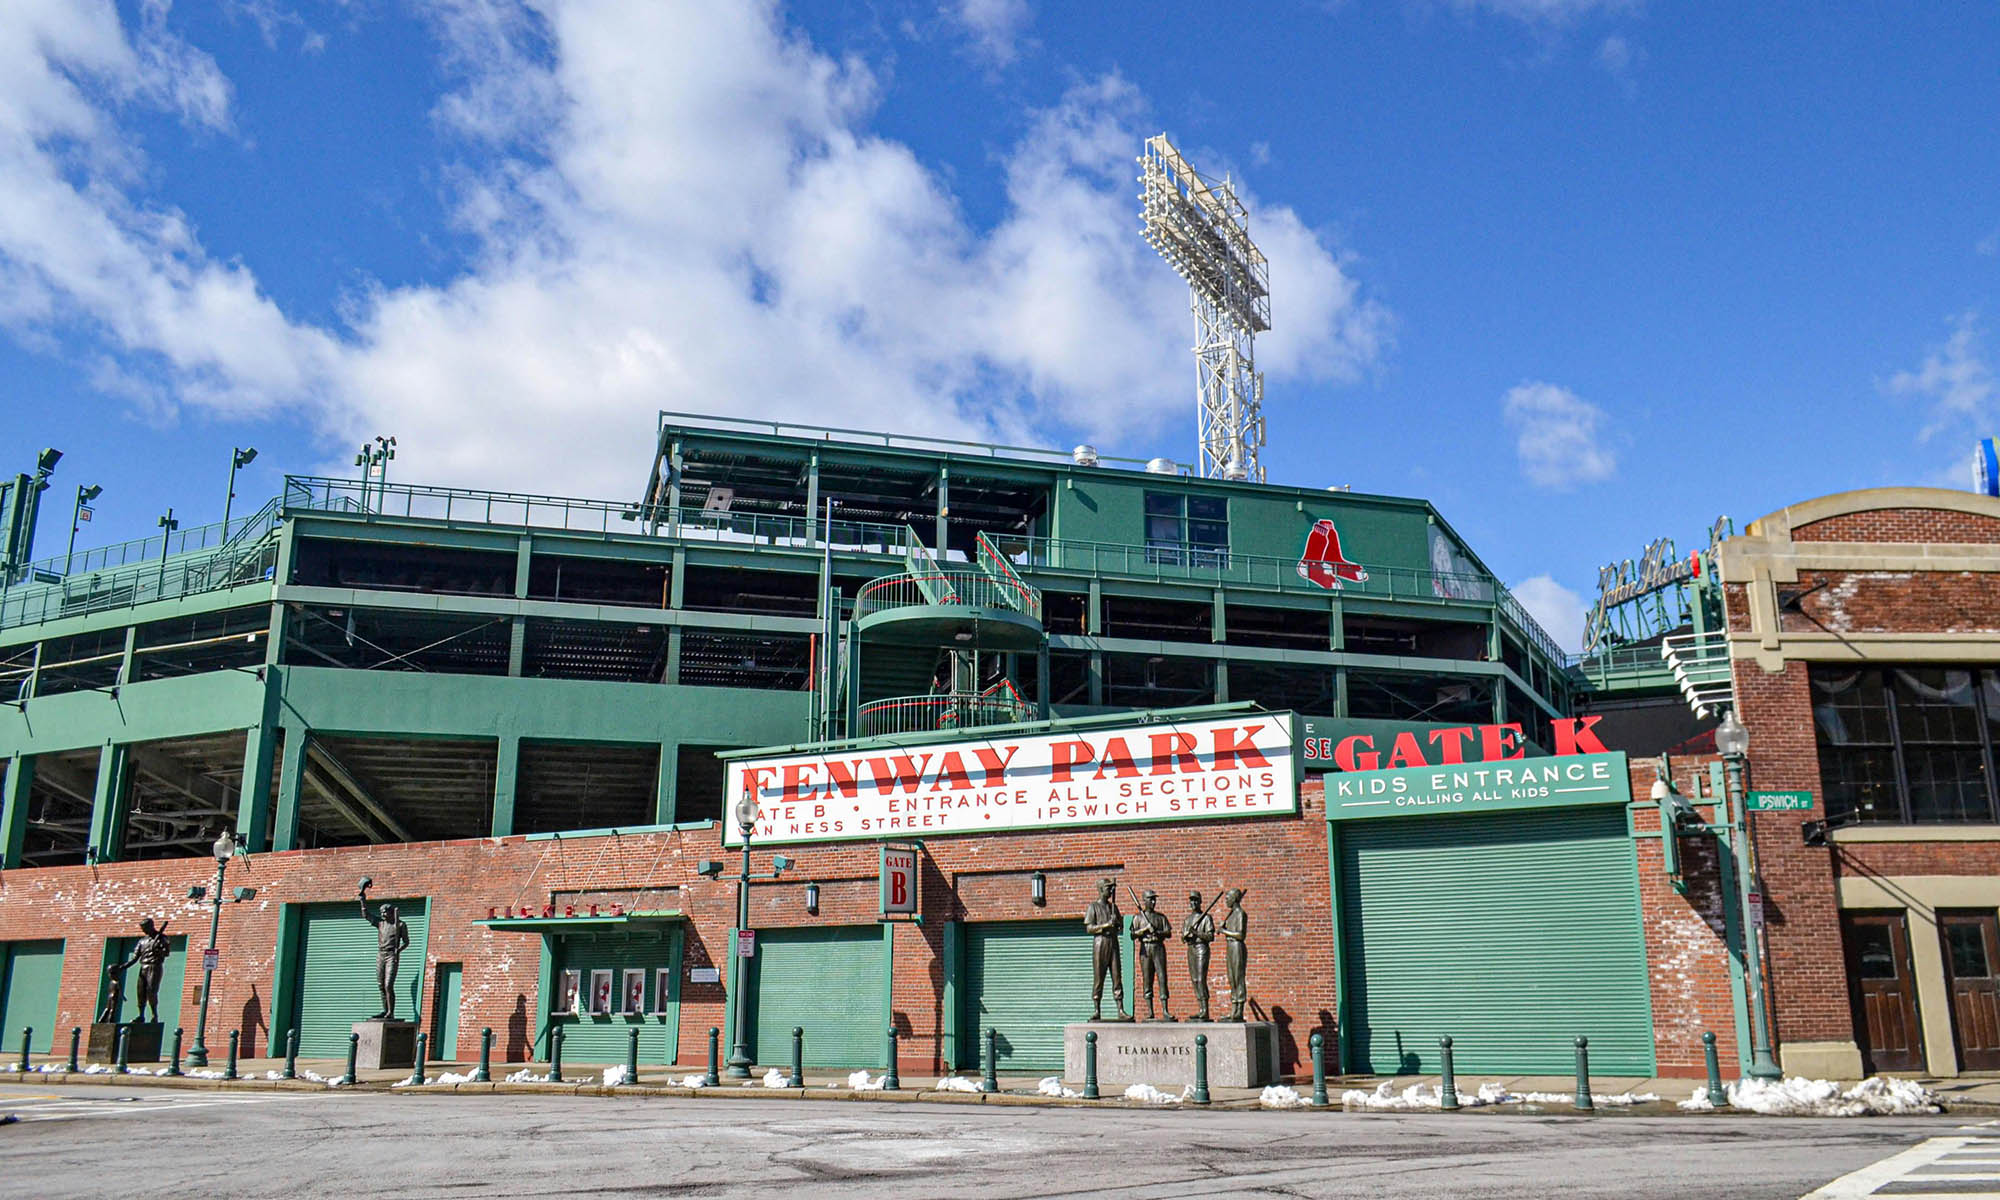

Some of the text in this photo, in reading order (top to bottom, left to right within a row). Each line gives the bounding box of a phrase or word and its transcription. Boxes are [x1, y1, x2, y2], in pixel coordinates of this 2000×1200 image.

[1334, 715, 1611, 772] GATE K
[741, 725, 1272, 804] FENWAY PARK
[1338, 761, 1610, 797] KIDS ENTRANCE
[756, 772, 1274, 821] ATE B ENTRANCE ALL SECTIONS
[790, 820, 844, 834] NESS
[861, 814, 948, 830] STREET
[1037, 801, 1148, 819] IPSWICH
[1170, 792, 1274, 811] STREET
[1395, 786, 1549, 807] CALLING ALL KIDS
[1758, 794, 1798, 809] IPSWICH
[885, 856, 912, 869] GATE
[891, 871, 908, 905] B
[1117, 1045, 1191, 1056] TEAMMATES
